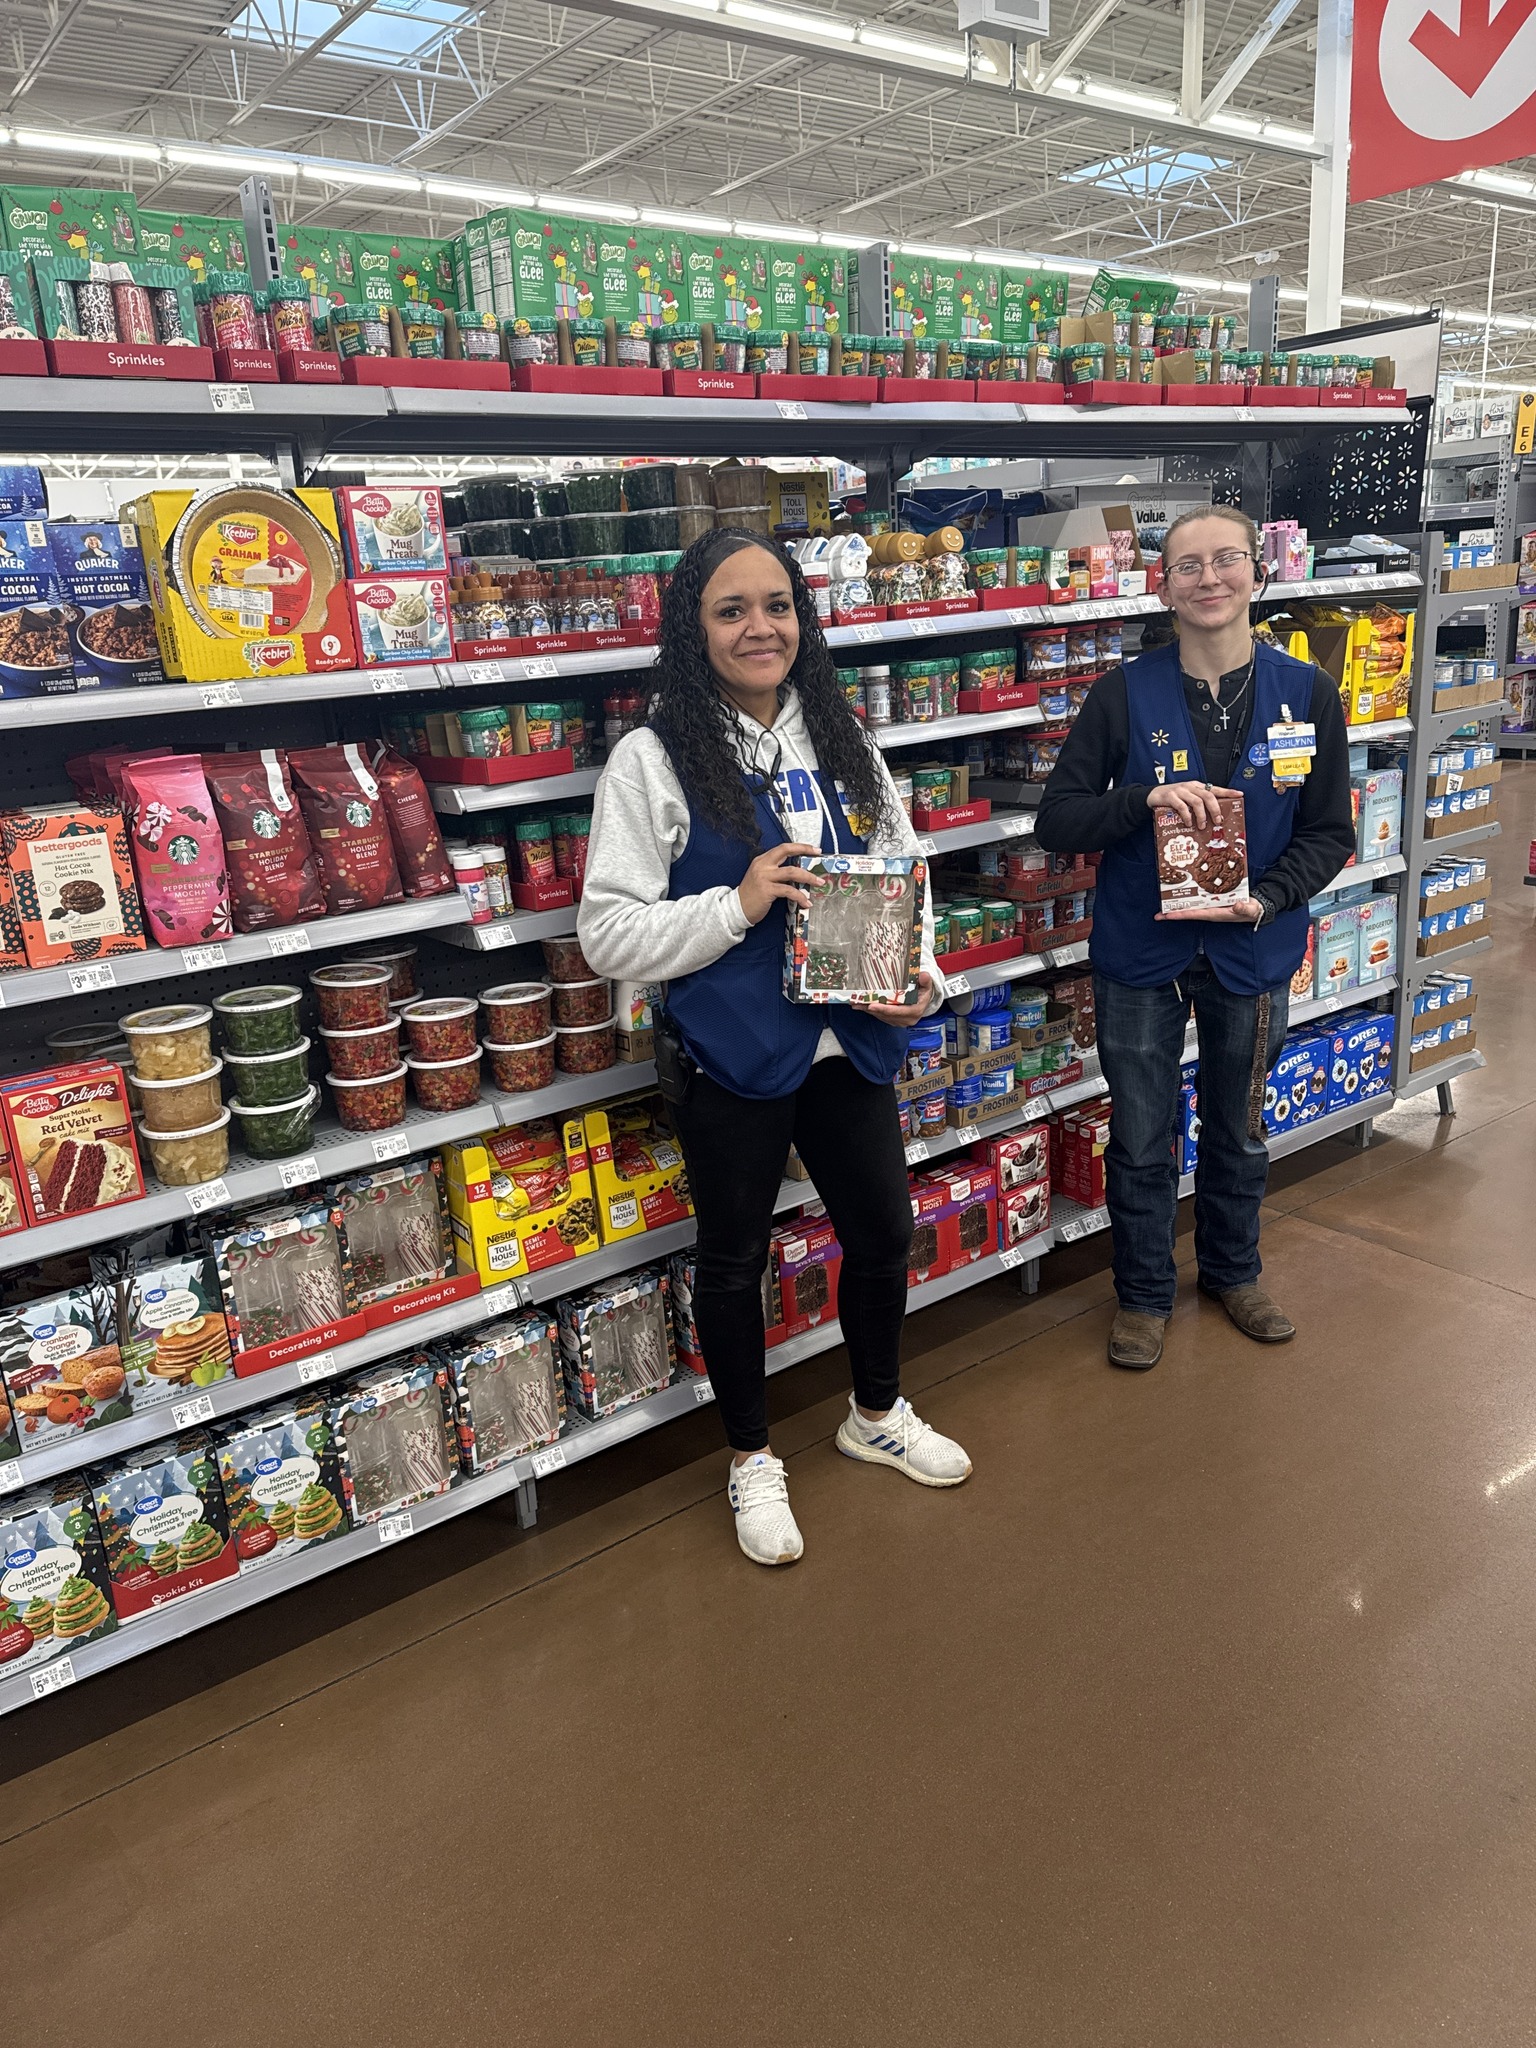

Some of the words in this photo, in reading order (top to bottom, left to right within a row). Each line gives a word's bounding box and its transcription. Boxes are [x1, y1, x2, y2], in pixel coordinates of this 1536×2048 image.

[10, 209, 48, 229] GRINCH
[515, 230, 542, 248] GRINCH
[600, 245, 626, 262] GRINCH
[361, 254, 389, 270] GRINCH
[689, 254, 713, 270] GRINCH
[411, 326, 435, 341] Wilton
[108, 352, 165, 366] Sprinkles
[233, 358, 272, 370] Sprinkles
[299, 360, 337, 372] Sprinkles
[698, 378, 734, 391] Sprinkles
[1332, 390, 1353, 401] Sprinkles
[1376, 392, 1397, 403] Sprinkles
[1521, 426, 1530, 438] E
[1519, 441, 1527, 452] 6
[363, 496, 385, 508] Betty
[786, 498, 802, 507] TOLL
[1128, 492, 1166, 512] Great
[783, 507, 806, 516] HOUSE
[1136, 510, 1168, 524] Value.
[222, 523, 256, 541] Keebler
[390, 539, 413, 550] Mug
[219, 547, 262, 561] GRAHAM
[387, 549, 419, 559] Treats
[1093, 547, 1112, 560] FANCY
[75, 558, 119, 571] QUAKER
[1, 585, 37, 595] COCOA
[74, 585, 95, 594] HOT
[97, 583, 130, 593] COCOA
[906, 605, 930, 616] Sprinkles
[945, 600, 969, 611] Sprinkles
[850, 611, 877, 620] Sprinkles
[395, 629, 418, 640] Mug
[596, 635, 626, 645] Sprinkles
[391, 639, 424, 649] Treats
[474, 644, 507, 655] Sprinkles
[536, 640, 567, 651] Sprinkles
[252, 646, 290, 662] Keebler
[997, 690, 1023, 702] Sprinkles
[529, 723, 547, 732] Wilton
[1274, 737, 1313, 749] ASHLYNN
[398, 794, 418, 804] CHEERS
[1373, 794, 1398, 806] BRIDGERTON
[946, 809, 974, 822] Sprinkles
[34, 838, 102, 854] bettergoods
[342, 834, 384, 848] STARBUCKS
[249, 846, 294, 860] STARBUCKS
[350, 843, 380, 853] HOLIDAY
[1170, 843, 1184, 852] ELF
[259, 855, 288, 866] HOLIDAY
[356, 850, 377, 859] BLEND
[530, 850, 552, 862] Wilton
[1171, 854, 1195, 864] SHELF
[69, 862, 91, 870] Cocoa
[265, 862, 285, 872] BLEND
[163, 881, 215, 893] PEPPERMINT
[174, 890, 206, 899] MOCHA
[538, 889, 569, 901] Sprinkles
[1366, 918, 1394, 932] BRIDGERTON
[1327, 930, 1354, 944] BRIDGERTON
[1348, 1026, 1378, 1049] OREO
[980, 1052, 1016, 1070] FROSTING
[1277, 1051, 1310, 1076] OREO
[907, 1076, 946, 1096] FROSTING
[983, 1080, 1004, 1088] Vanilla
[60, 1083, 115, 1107] Delights
[24, 1096, 49, 1109] Betty
[983, 1093, 1019, 1113] FROSTING
[22, 1104, 57, 1116] Crocker
[49, 1112, 70, 1121] Super
[71, 1108, 91, 1117] Moist
[41, 1123, 65, 1136] Red
[66, 1114, 103, 1128] Velvet
[59, 1130, 75, 1139] cake
[493, 1139, 517, 1151] SEMI-
[496, 1143, 524, 1158] SWEET
[596, 1146, 607, 1156] 12
[973, 1174, 993, 1185] PERFECTLY
[974, 1179, 992, 1190] MOIST
[474, 1183, 486, 1194] 12
[473, 1191, 489, 1200] OUNCE
[642, 1195, 658, 1206] SEMI-
[922, 1195, 943, 1205] PERFECTLY
[975, 1193, 987, 1202] FOOD
[615, 1204, 632, 1213] TOLL
[644, 1199, 662, 1211] SWEET
[923, 1200, 943, 1213] MOIST
[333, 1213, 341, 1221] 12
[613, 1209, 636, 1221] HOUSE
[924, 1214, 937, 1223] FOOD
[524, 1236, 543, 1247] SEMI-
[810, 1233, 831, 1244] PERFECTLY
[811, 1238, 832, 1251] MOIST
[495, 1244, 513, 1255] TOLL
[525, 1239, 547, 1253] SWEET
[786, 1242, 805, 1256] Duncan
[491, 1250, 518, 1263] HOUSE
[795, 1257, 813, 1269] DEVIL'S
[813, 1252, 825, 1262] FOOD
[147, 1291, 164, 1300] Great
[393, 1292, 442, 1314] Decorating
[443, 1287, 456, 1299] Kit
[145, 1305, 163, 1316] Apple
[164, 1297, 195, 1310] Cinnamon
[35, 1326, 53, 1336] Great
[40, 1331, 78, 1348] Cranberry
[269, 1335, 321, 1360] Decorating
[323, 1328, 338, 1340] Kit
[46, 1339, 75, 1353] Orange
[50, 1353, 66, 1362] Muffin
[26, 1440, 34, 1449] NET
[257, 1460, 278, 1471] Great
[269, 1469, 301, 1485] Holiday
[257, 1478, 298, 1498] Christmas
[299, 1470, 315, 1482] Tree
[273, 1486, 294, 1498] Cookie
[137, 1498, 159, 1510] Great
[149, 1505, 183, 1523] Holiday
[136, 1515, 180, 1537] Christmas
[181, 1508, 198, 1520] Tree
[154, 1526, 177, 1537] Cookie
[177, 1521, 185, 1530] Kit
[8, 1551, 32, 1565] Great
[22, 1559, 59, 1579] Holiday
[8, 1571, 55, 1593] Christmas
[56, 1562, 76, 1575] Tree
[27, 1580, 52, 1593] Cookie
[52, 1576, 61, 1585] Kit
[151, 1585, 187, 1605] Cookie
[189, 1578, 205, 1590] Kit
